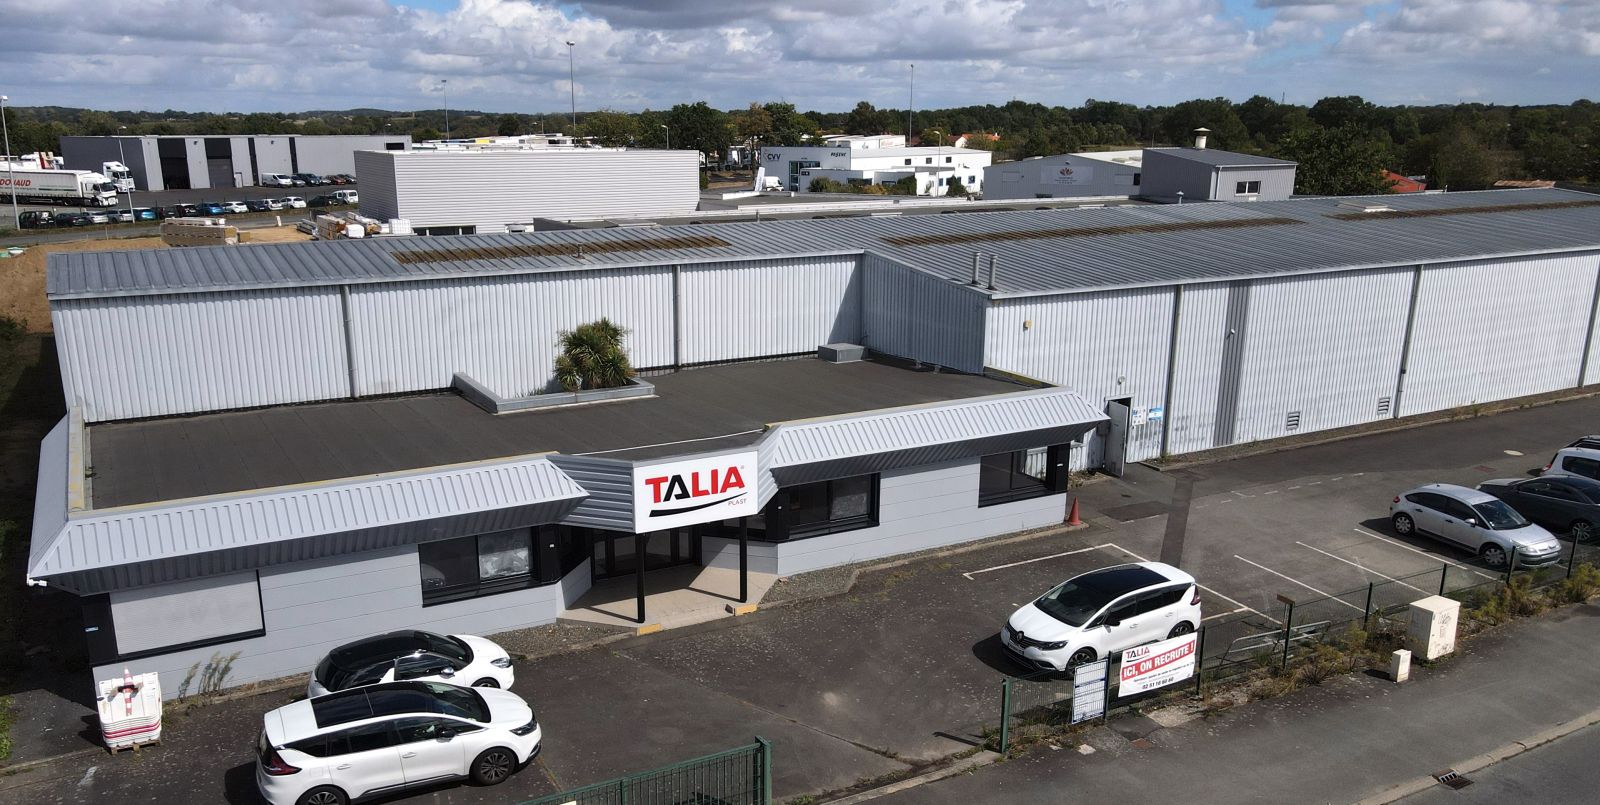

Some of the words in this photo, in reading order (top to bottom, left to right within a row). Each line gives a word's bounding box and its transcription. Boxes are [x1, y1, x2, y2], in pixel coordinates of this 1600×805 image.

[0, 178, 31, 187] DOAUD
[645, 466, 745, 504] TALIA
[728, 498, 747, 506] PLAST
[1126, 646, 1150, 659] TALIA
[1123, 665, 1138, 678] ICI,
[1140, 659, 1152, 672] ON
[1154, 647, 1189, 665] RECRUTE
